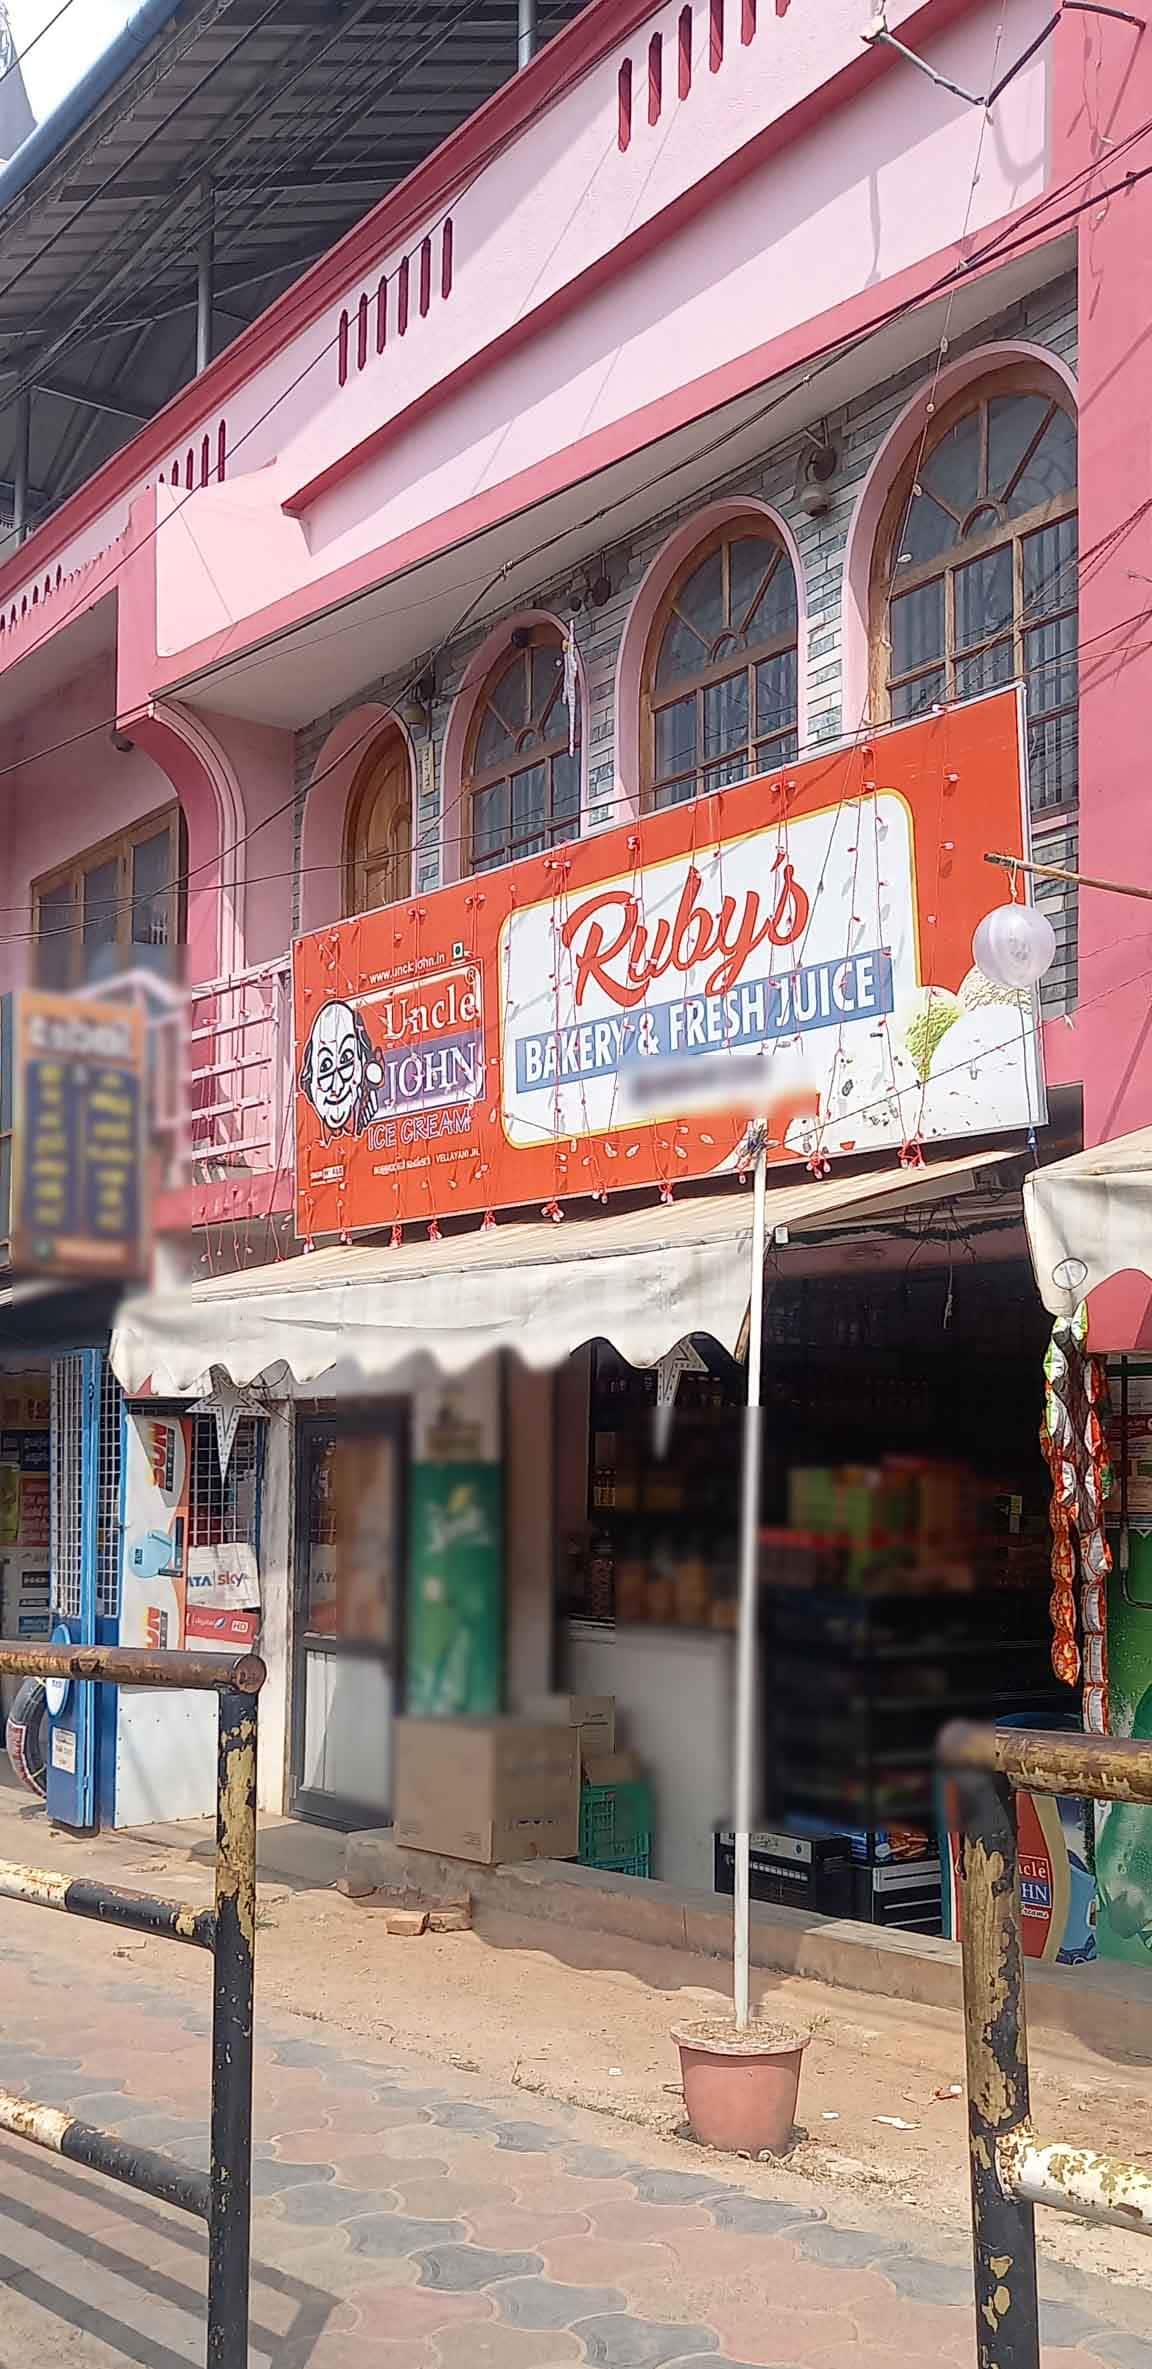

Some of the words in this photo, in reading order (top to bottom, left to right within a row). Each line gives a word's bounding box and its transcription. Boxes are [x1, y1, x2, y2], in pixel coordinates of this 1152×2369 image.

[561, 852, 810, 1007] Ruby's
[384, 984, 477, 1040] Uncle
[524, 1019, 629, 1084] BAKERY
[637, 1017, 661, 1056] &
[669, 986, 765, 1051] FRESH
[774, 956, 876, 1028] JUICE
[384, 1042, 477, 1109] JOHN
[367, 1121, 397, 1151] ICE
[400, 1108, 471, 1145] CREAM
[148, 1422, 168, 1490] SUN
[146, 1606, 161, 1650] UN
[1018, 1861, 1047, 1879] cle
[1021, 1882, 1048, 1902] HN
